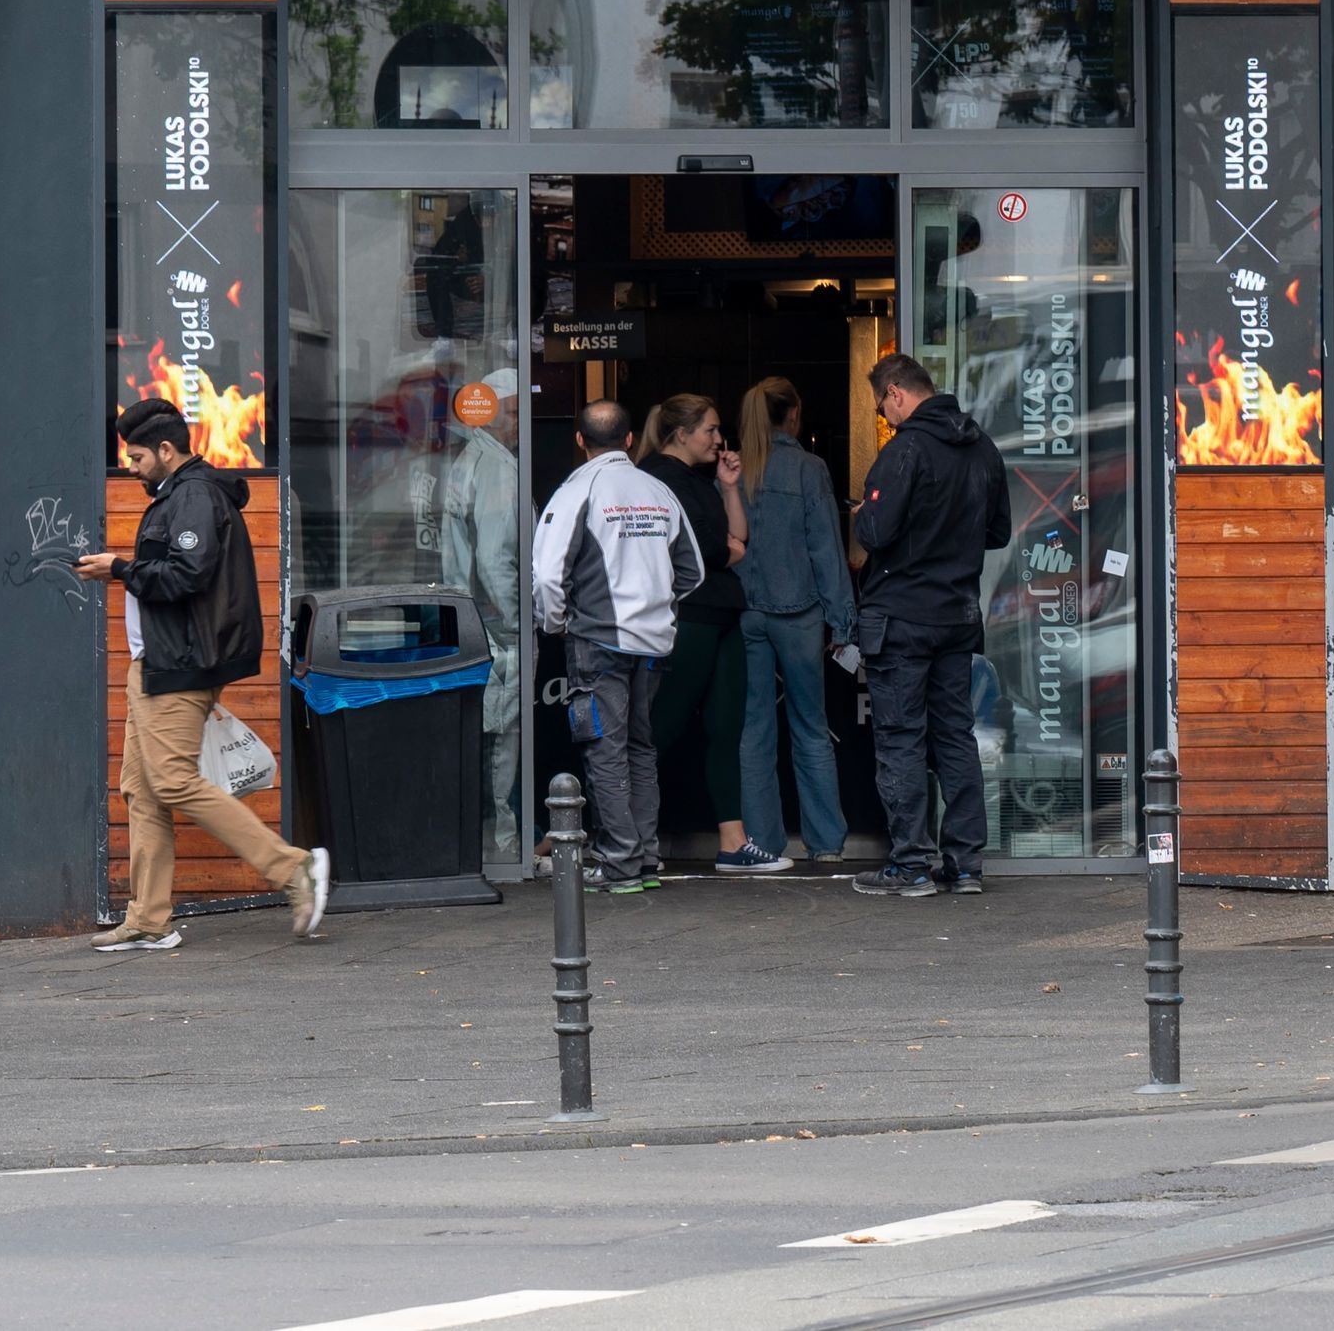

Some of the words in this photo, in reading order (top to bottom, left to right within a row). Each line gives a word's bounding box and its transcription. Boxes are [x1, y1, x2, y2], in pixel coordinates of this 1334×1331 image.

[166, 116, 186, 190] LUKAS
[1225, 117, 1245, 190] LUKAS
[171, 295, 215, 425] mangal
[553, 322, 603, 334] Bestellung
[604, 323, 616, 331] an
[617, 321, 634, 331] der
[570, 335, 618, 350] KASSE
[1231, 295, 1274, 422] mangal
[1022, 368, 1047, 456] LUKAS
[1027, 583, 1081, 743] mangal
